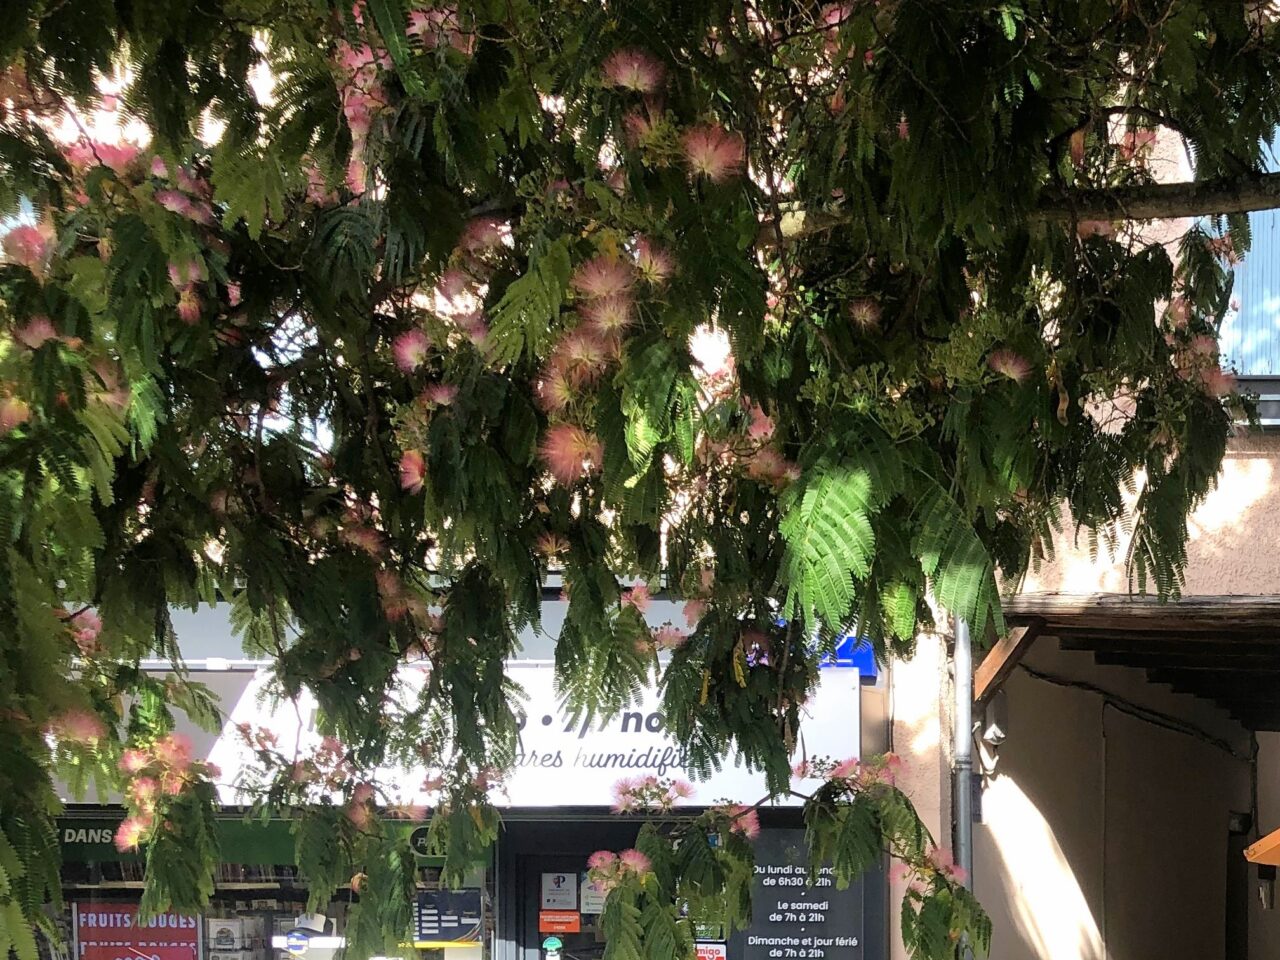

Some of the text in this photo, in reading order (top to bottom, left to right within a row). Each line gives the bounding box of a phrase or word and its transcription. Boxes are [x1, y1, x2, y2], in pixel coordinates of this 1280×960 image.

[621, 711, 666, 733] no
[64, 828, 113, 843] DANS
[767, 865, 793, 875] lundi
[762, 877, 776, 886] de
[778, 877, 804, 887] 6h30
[815, 877, 832, 887] 21h
[777, 901, 829, 911] Le samedi
[79, 912, 196, 929] FRUITS OUGES
[769, 912, 825, 922] de 7h à 21h
[747, 935, 859, 949] Dimanche et jour férié
[697, 946, 721, 960] migo
[769, 948, 825, 958] de 7h à 21h
